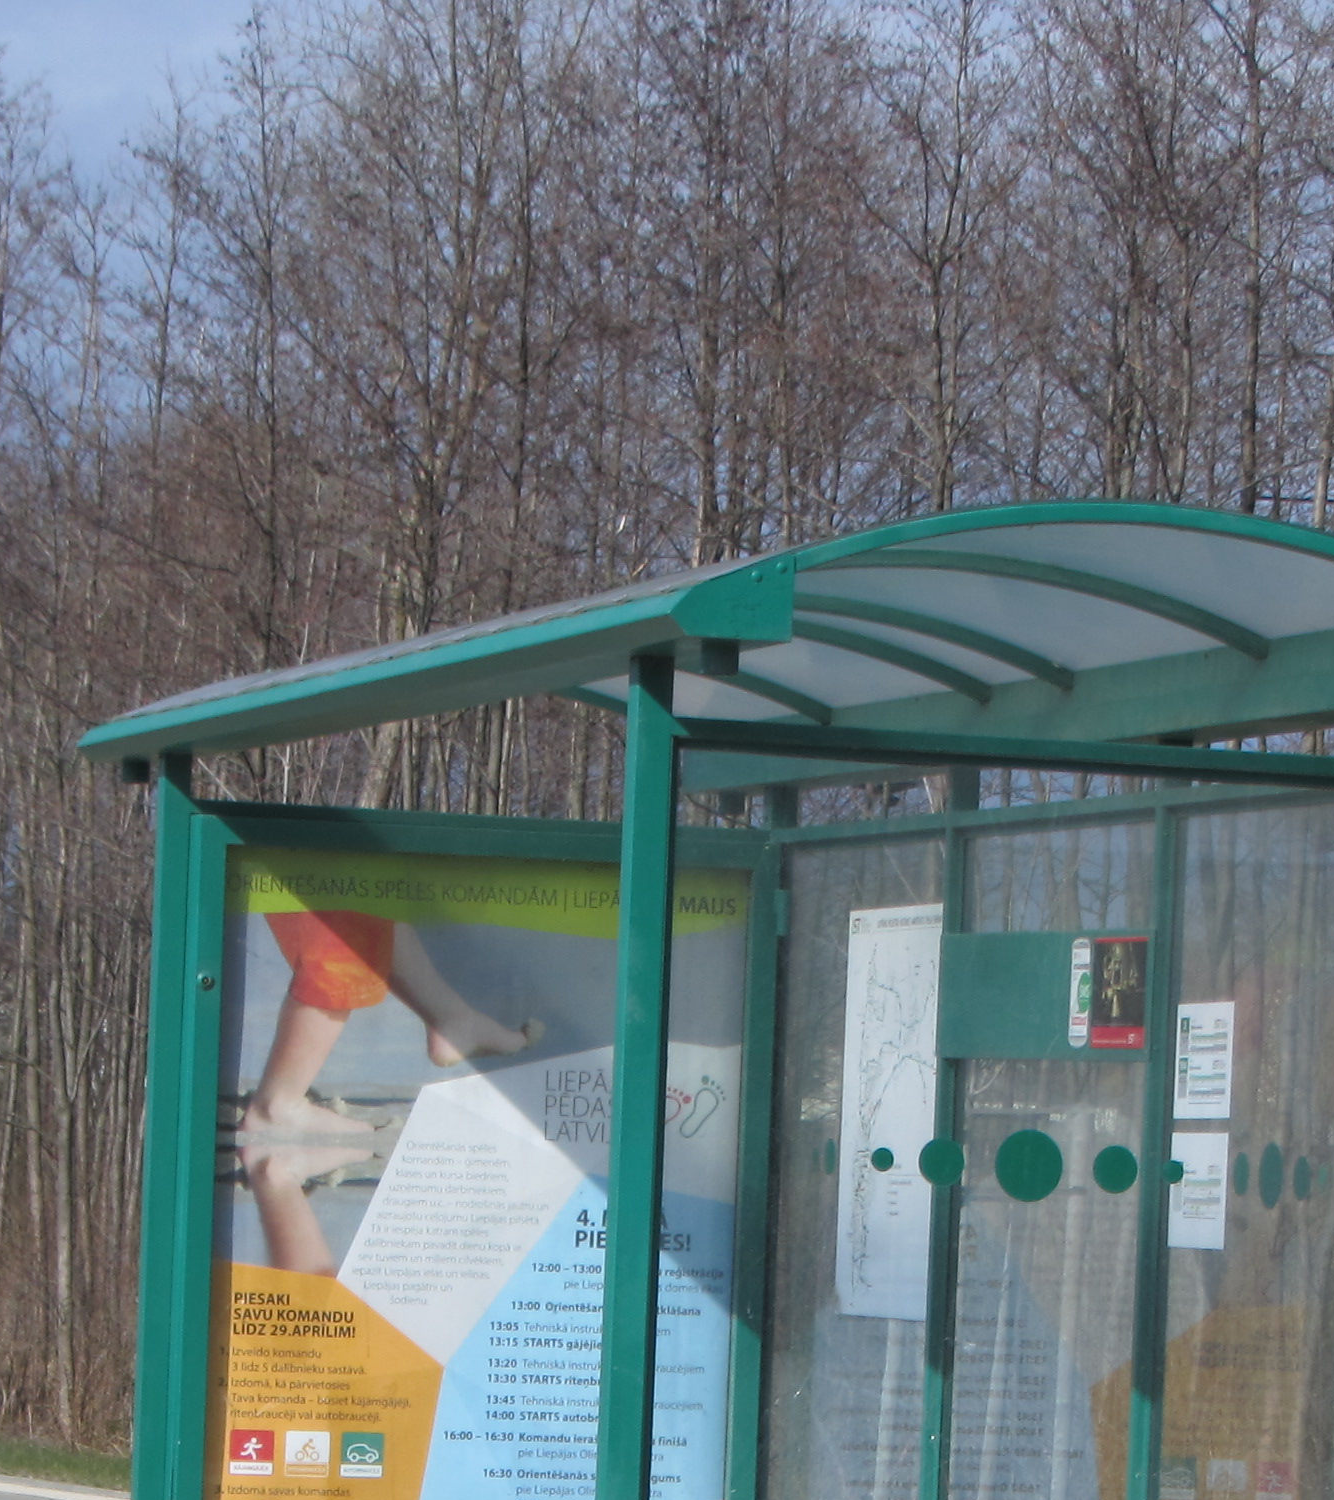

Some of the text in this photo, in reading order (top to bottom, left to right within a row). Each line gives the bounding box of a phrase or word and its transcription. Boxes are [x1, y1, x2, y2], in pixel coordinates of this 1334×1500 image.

[442, 883, 558, 907] KOMANDĀM
[573, 889, 621, 909] LIEPĀ
[679, 896, 736, 916] MAIJS
[545, 1068, 611, 1095] LIEPĀ
[543, 1120, 610, 1144] LATVI
[575, 1209, 596, 1227] 4.
[531, 1262, 561, 1274] 12:00
[572, 1263, 602, 1275] 13:00
[563, 1280, 580, 1291] pie
[581, 1279, 604, 1291] Liep
[233, 1291, 291, 1306] PIESAKI
[510, 1301, 541, 1312] 13:00
[232, 1307, 355, 1324] SAVU KOMANDU
[489, 1321, 519, 1332] 13:05
[489, 1336, 519, 1348] 13:15
[522, 1337, 564, 1349] STARTS
[272, 1347, 322, 1359] komandu
[487, 1358, 518, 1369] 13:20
[487, 1373, 563, 1386] 13:30 STARTS
[257, 1394, 306, 1404] komanda
[486, 1394, 516, 1405] 13:45
[485, 1410, 515, 1421] 14:00
[519, 1411, 561, 1422] STARTS
[443, 1430, 473, 1441] 16:00
[484, 1431, 514, 1442] 16:30
[518, 1432, 571, 1443] Komandu
[518, 1449, 535, 1460] pie
[482, 1468, 513, 1479] 16:30
[298, 1486, 351, 1498] komandas
[515, 1485, 532, 1496] pie
